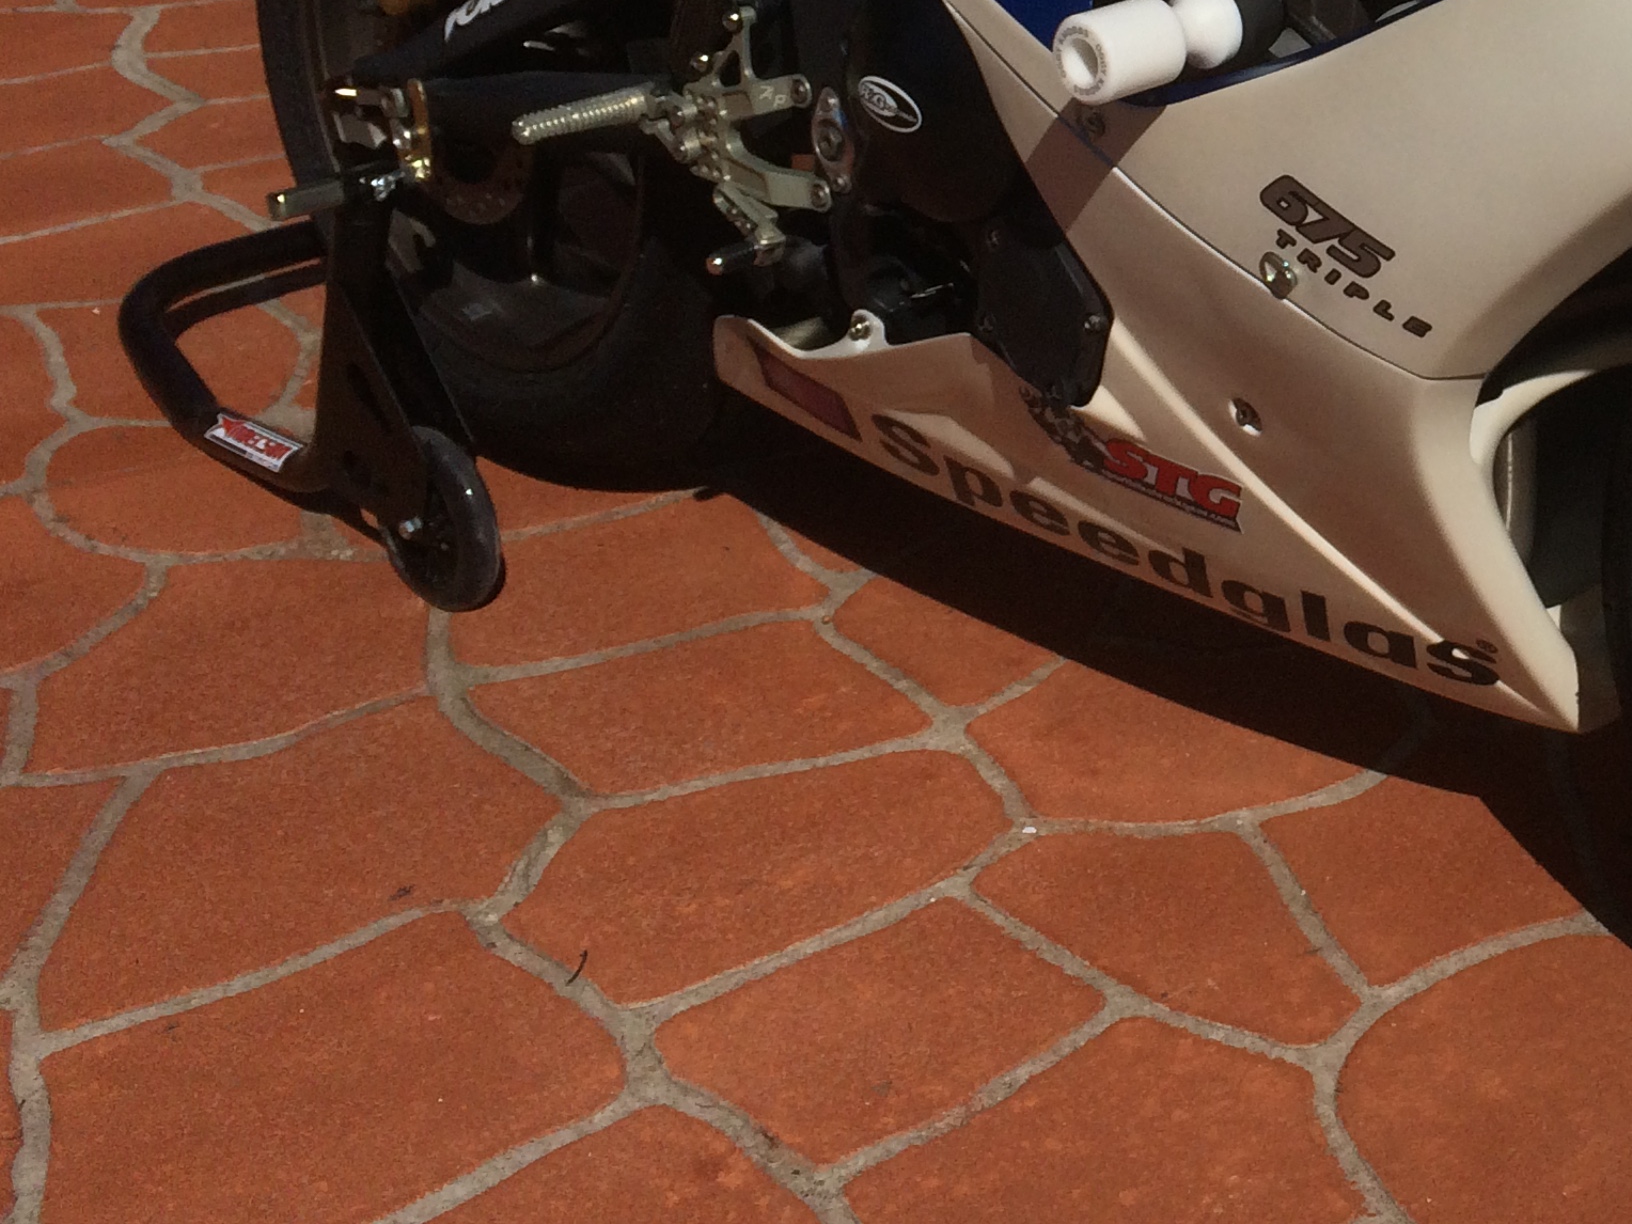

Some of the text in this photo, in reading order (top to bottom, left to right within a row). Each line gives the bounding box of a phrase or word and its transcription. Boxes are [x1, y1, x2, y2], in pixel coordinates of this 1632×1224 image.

[1259, 174, 1396, 278] 675
[1276, 228, 1433, 338] TRIPLE
[1102, 437, 1243, 520] STG
